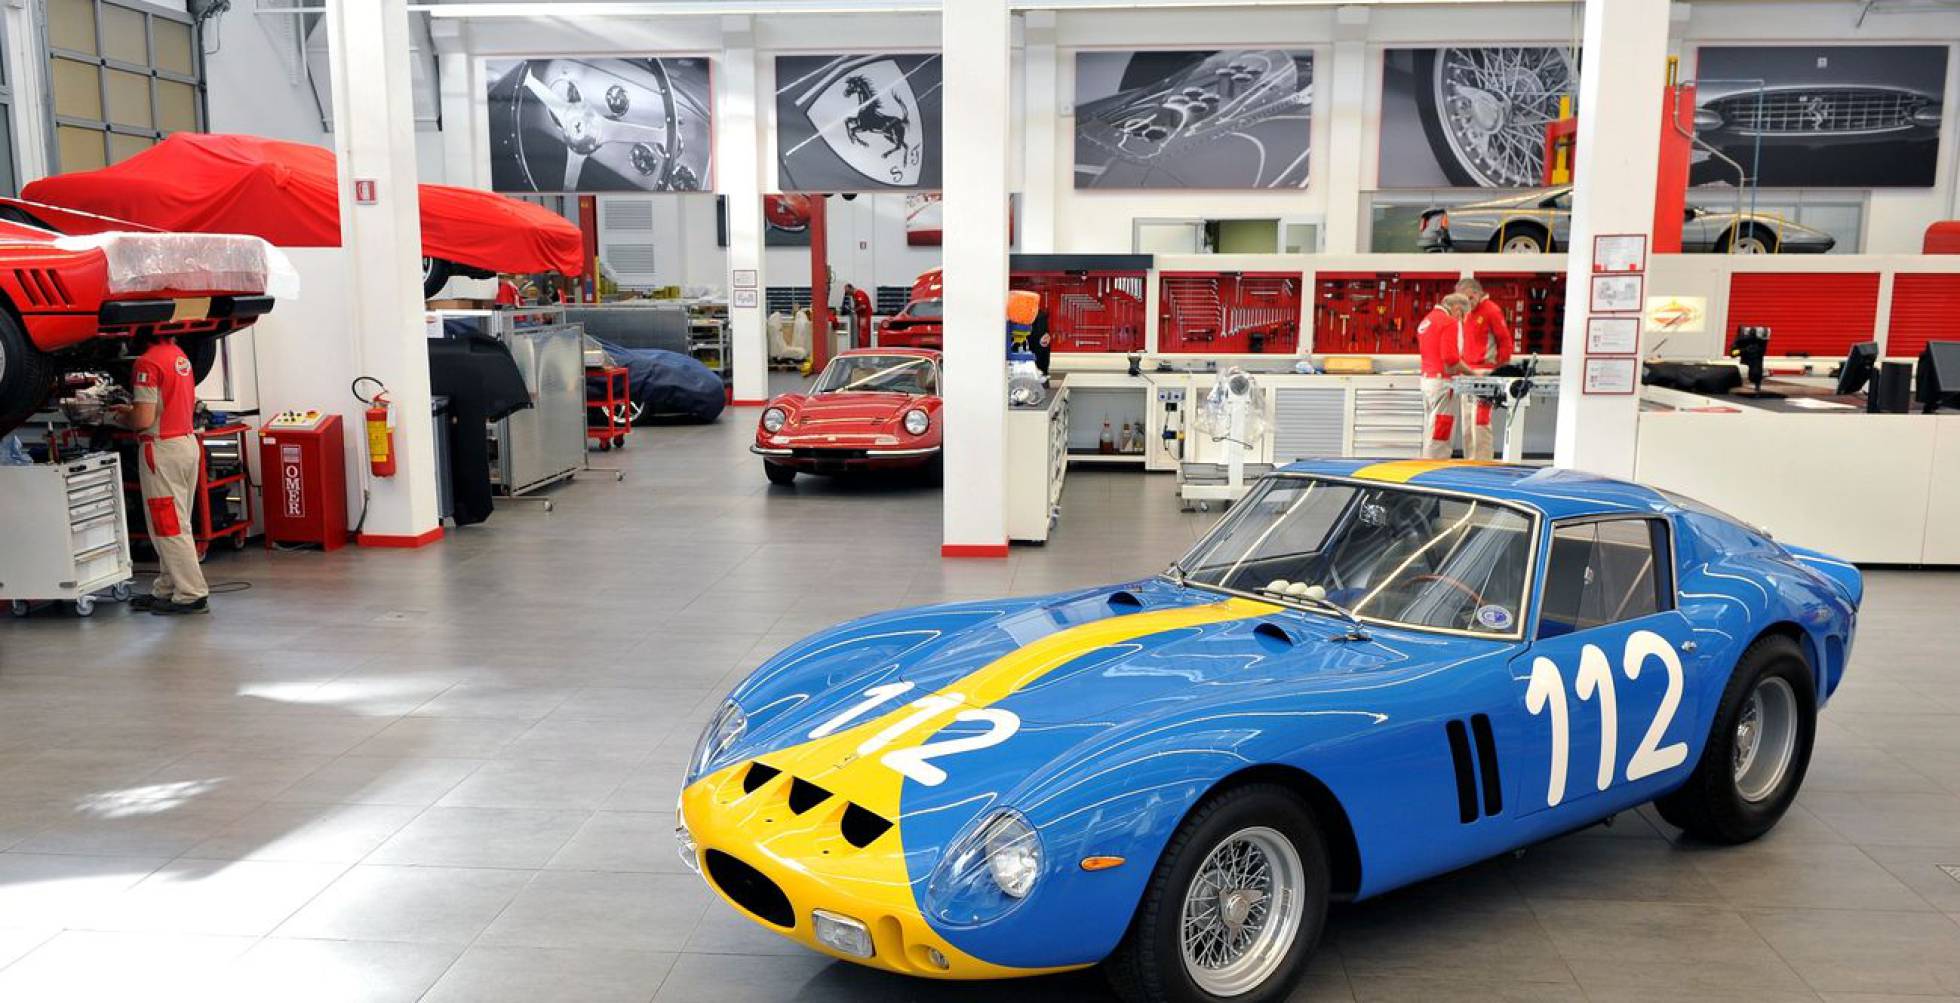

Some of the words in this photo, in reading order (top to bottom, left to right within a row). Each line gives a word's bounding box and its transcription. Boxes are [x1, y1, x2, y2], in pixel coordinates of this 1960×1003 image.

[286, 465, 301, 515] OMER
[808, 681, 1021, 787] 112
[1526, 630, 1688, 807] 112
